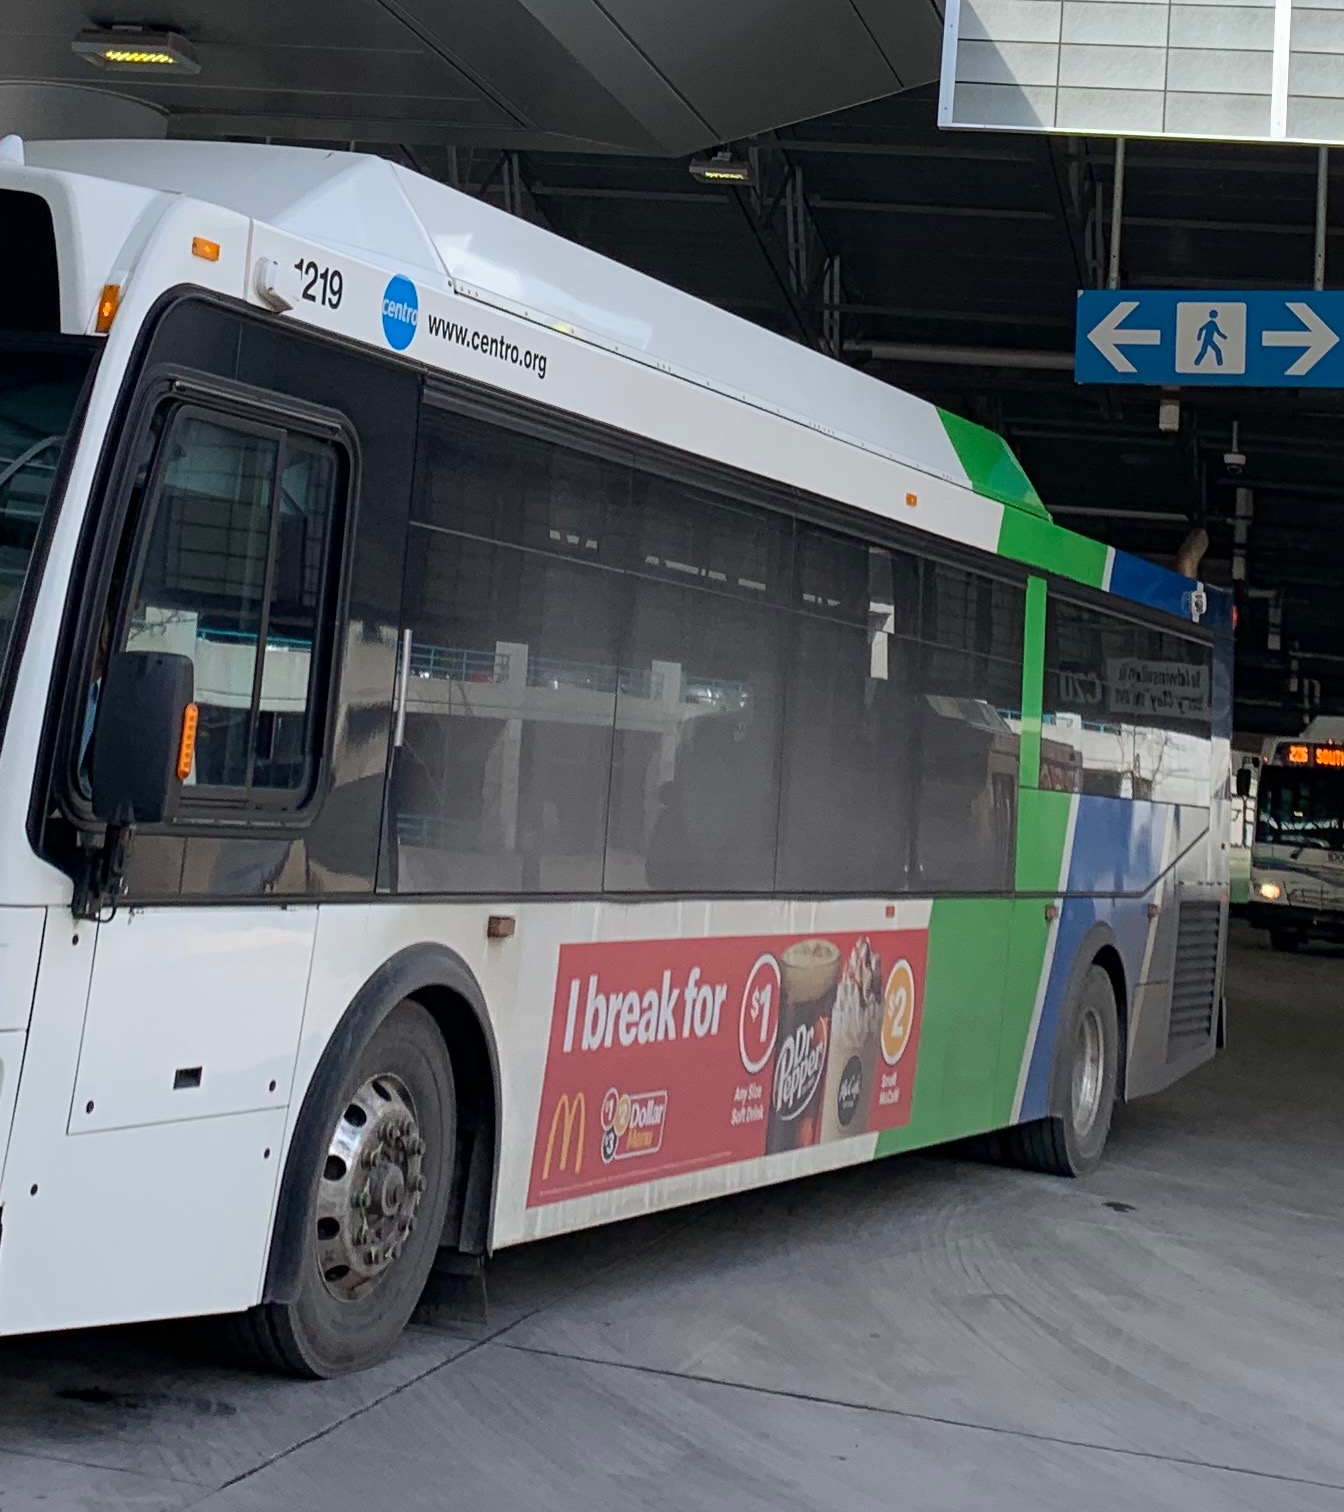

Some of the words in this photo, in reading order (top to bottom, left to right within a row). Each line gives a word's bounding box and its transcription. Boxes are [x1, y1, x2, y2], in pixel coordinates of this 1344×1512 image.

[382, 297, 419, 327] centro
[427, 313, 548, 381] www.centro.org
[562, 978, 581, 1053] I
[580, 968, 681, 1052] break
[682, 966, 727, 1039] for
[750, 982, 773, 1044] $1
[887, 986, 908, 1039] $2
[775, 1035, 824, 1113] Pepper
[630, 1098, 665, 1129] Dollar
